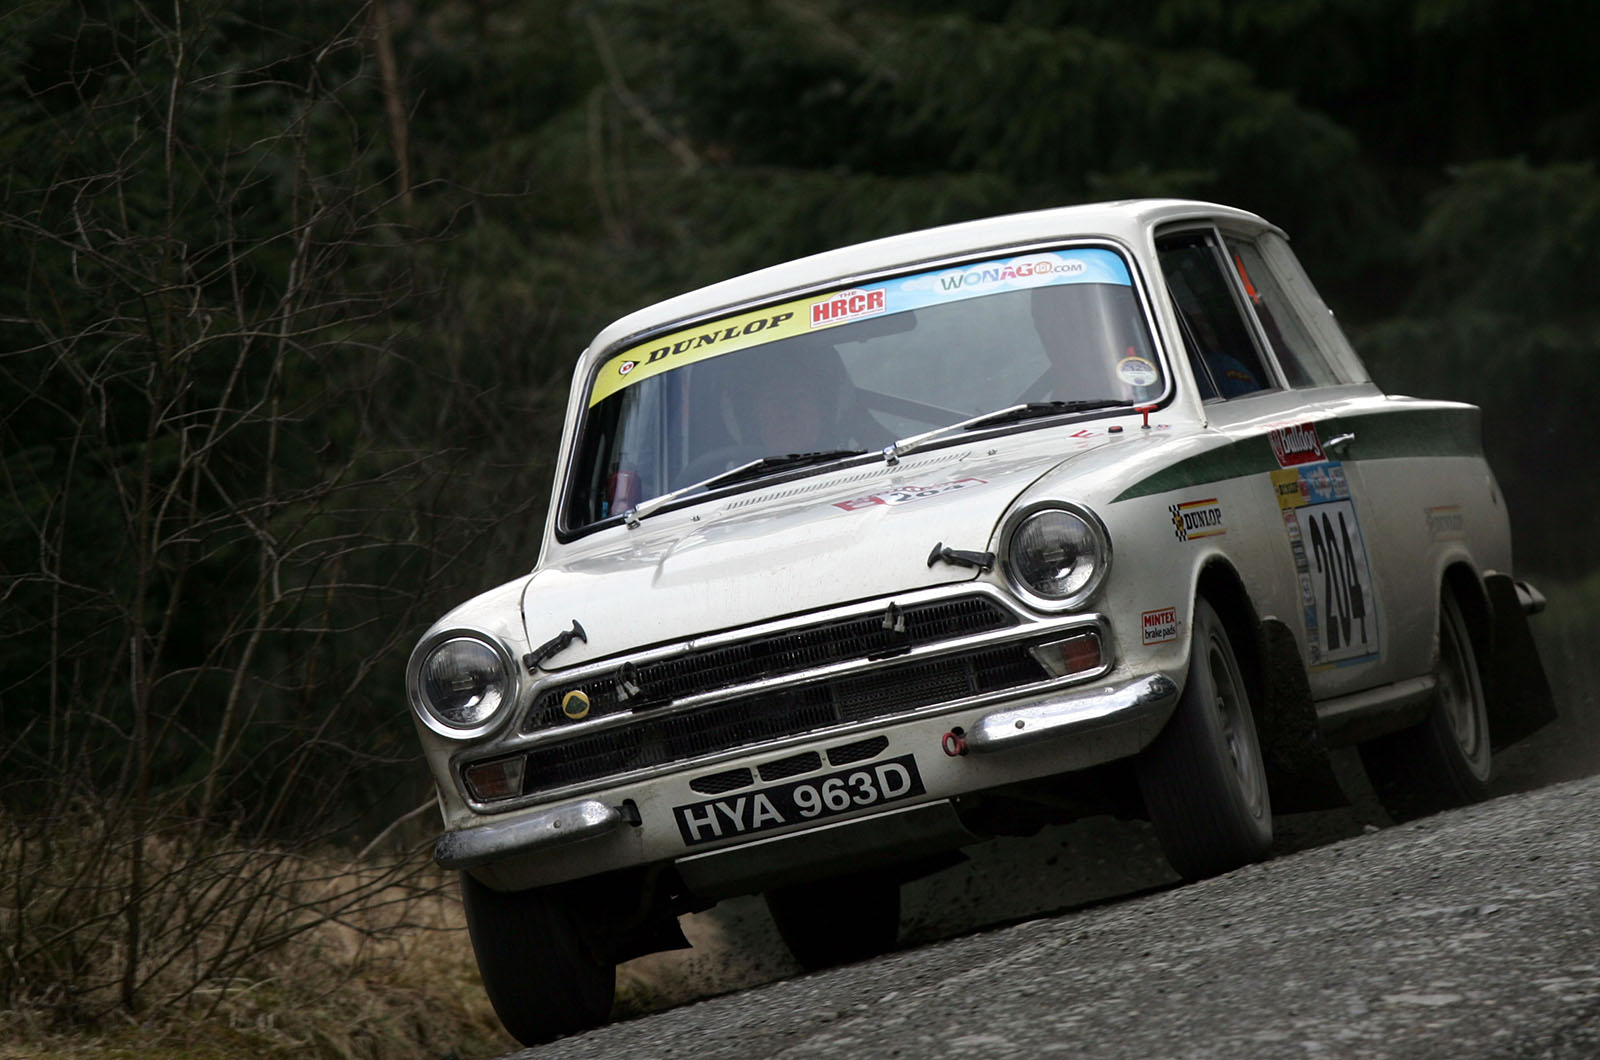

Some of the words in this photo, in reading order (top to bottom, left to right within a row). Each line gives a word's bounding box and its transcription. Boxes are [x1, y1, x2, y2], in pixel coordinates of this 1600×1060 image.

[813, 291, 884, 322] HRCR
[644, 312, 794, 365] DUNLOP
[1280, 424, 1321, 456] Bulldog
[1184, 508, 1222, 530] DUNLOP
[1309, 511, 1368, 651] 204
[1144, 611, 1176, 627] MINTEX
[1145, 628, 1162, 639] brake
[1163, 625, 1176, 639] pads
[682, 793, 786, 841] HYA
[792, 762, 912, 818] 963D
